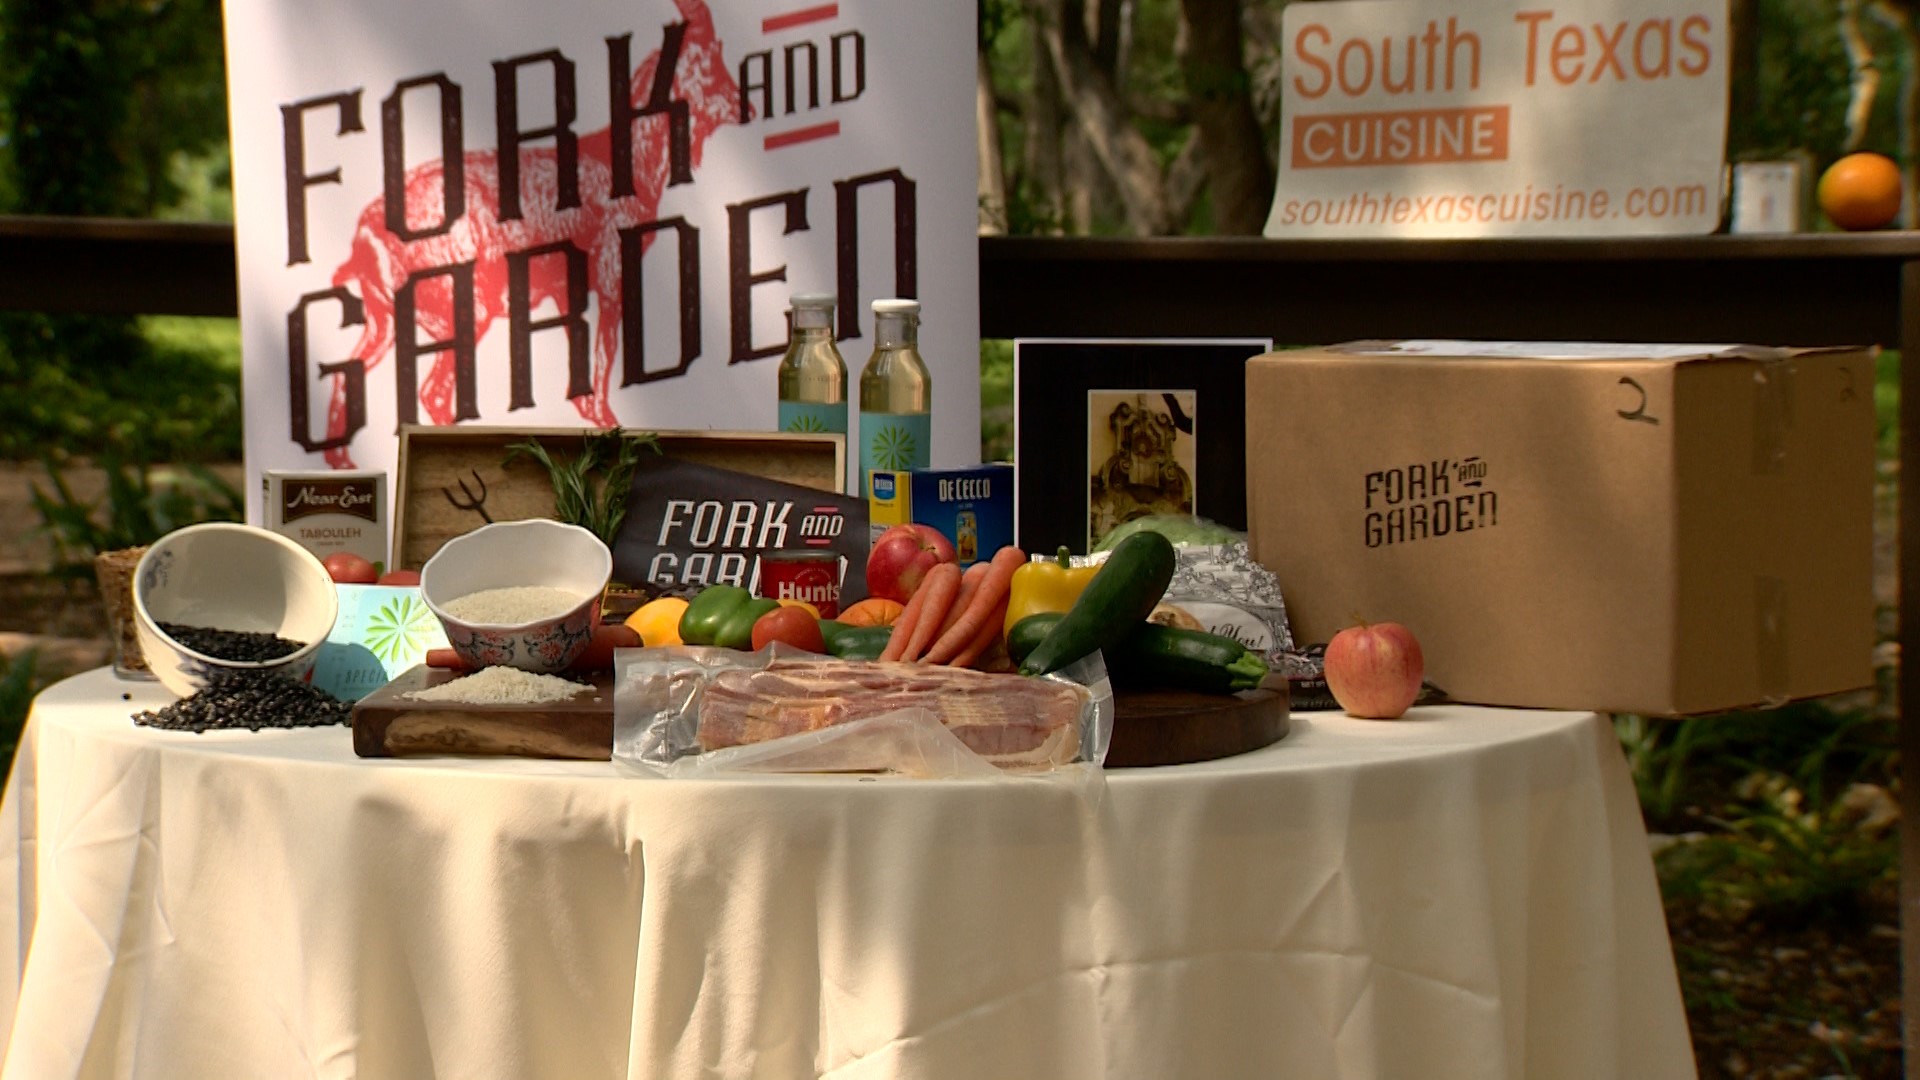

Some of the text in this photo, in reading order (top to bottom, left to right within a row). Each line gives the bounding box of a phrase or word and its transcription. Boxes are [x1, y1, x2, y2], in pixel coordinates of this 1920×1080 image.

[1294, 11, 1712, 99] South Texas
[280, 20, 866, 267] FORK AND
[1303, 112, 1496, 162] CUISINE
[1281, 182, 1708, 226] southtexascuisine.com
[287, 167, 917, 455] GARDEN
[287, 485, 373, 508] Near East
[1365, 459, 1487, 509] FORK AND
[300, 527, 362, 539] TABOULEH
[655, 500, 845, 549] FORK AND
[1365, 490, 1498, 548] GARDEN
[647, 552, 849, 600] GAR
